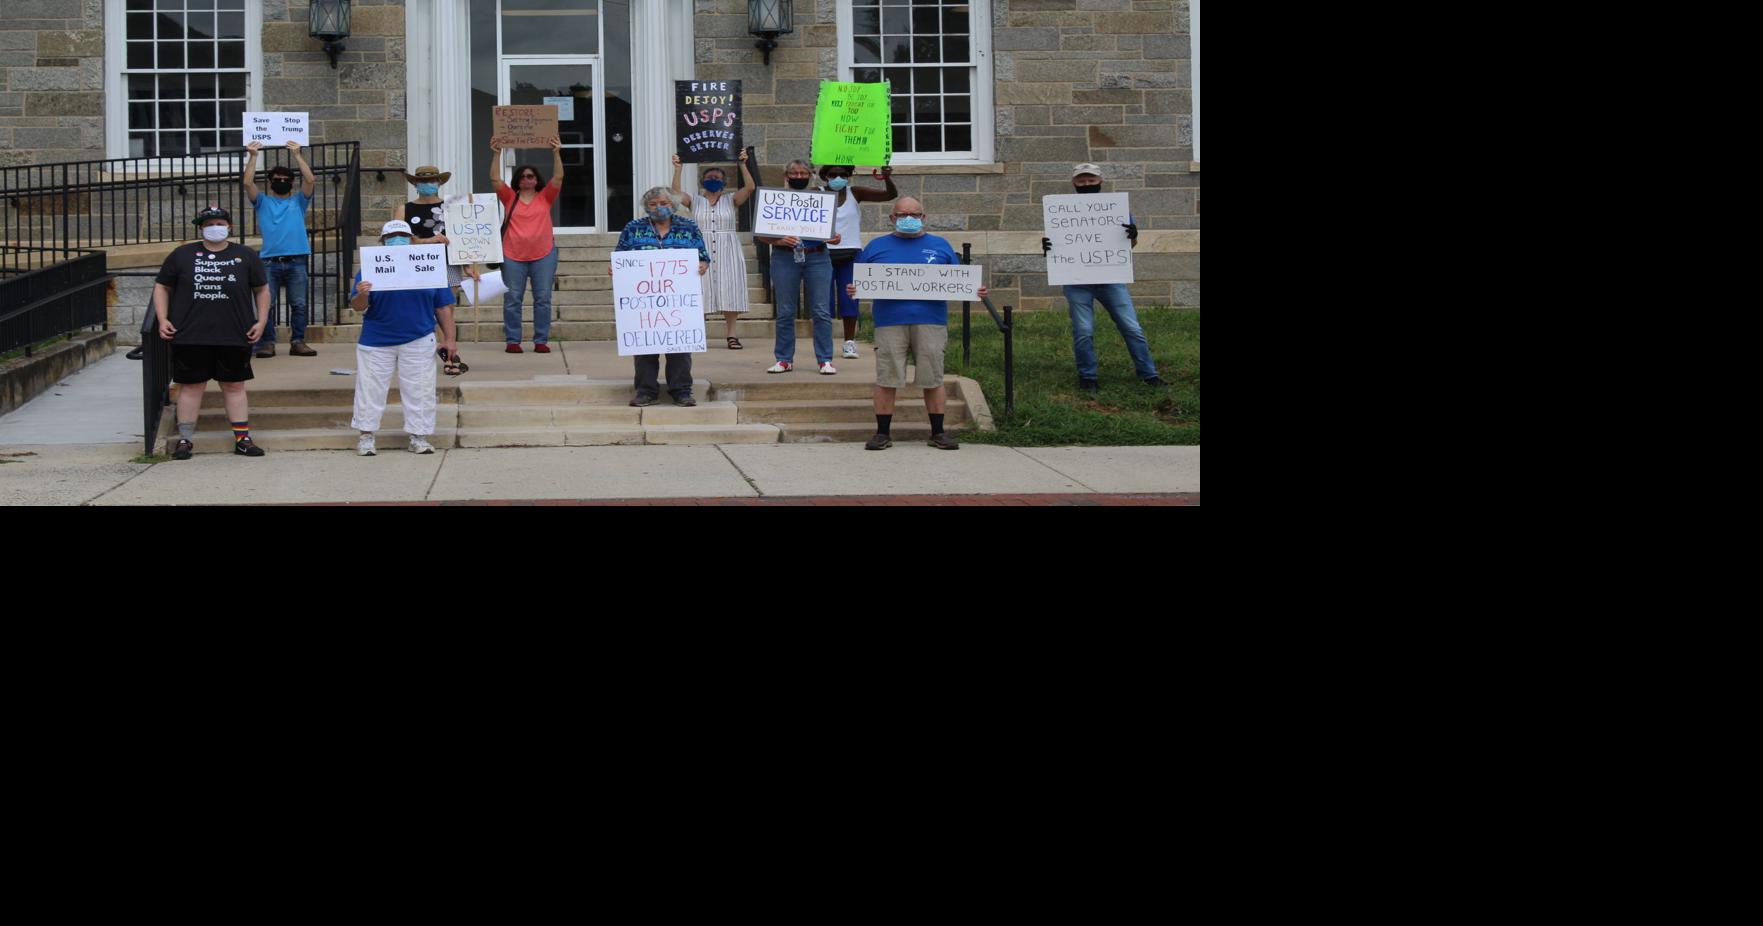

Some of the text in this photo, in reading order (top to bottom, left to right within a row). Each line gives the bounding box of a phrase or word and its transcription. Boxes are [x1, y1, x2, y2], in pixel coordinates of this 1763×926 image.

[692, 82, 727, 92] FIRE
[685, 94, 734, 106] DEJOY!
[683, 107, 736, 127] USPS
[840, 114, 860, 122] NOW
[834, 124, 860, 134] FIGHT
[683, 130, 735, 144] DESERVES
[690, 140, 730, 152] BETTER
[764, 192, 824, 209] US Postal
[461, 204, 485, 220] UP
[1048, 204, 1080, 214] CALL
[762, 206, 829, 224] SERVICE
[453, 223, 492, 236] USPS
[460, 236, 491, 246] DOWN
[1064, 233, 1103, 245] SAVE
[375, 254, 395, 262] U.S.
[426, 252, 440, 260] for
[194, 258, 235, 267] Support
[414, 264, 436, 272] Sale
[615, 258, 689, 278] SINCE 1775
[375, 266, 396, 274] Mail
[868, 268, 970, 278] I STAND WITH
[194, 274, 237, 282] Queer &
[194, 282, 222, 290] Trans
[636, 279, 676, 294] OUR
[854, 280, 904, 292] POSTAL
[193, 291, 230, 300] People.
[640, 310, 682, 329] HAS
[623, 328, 703, 348] DELIVERED
